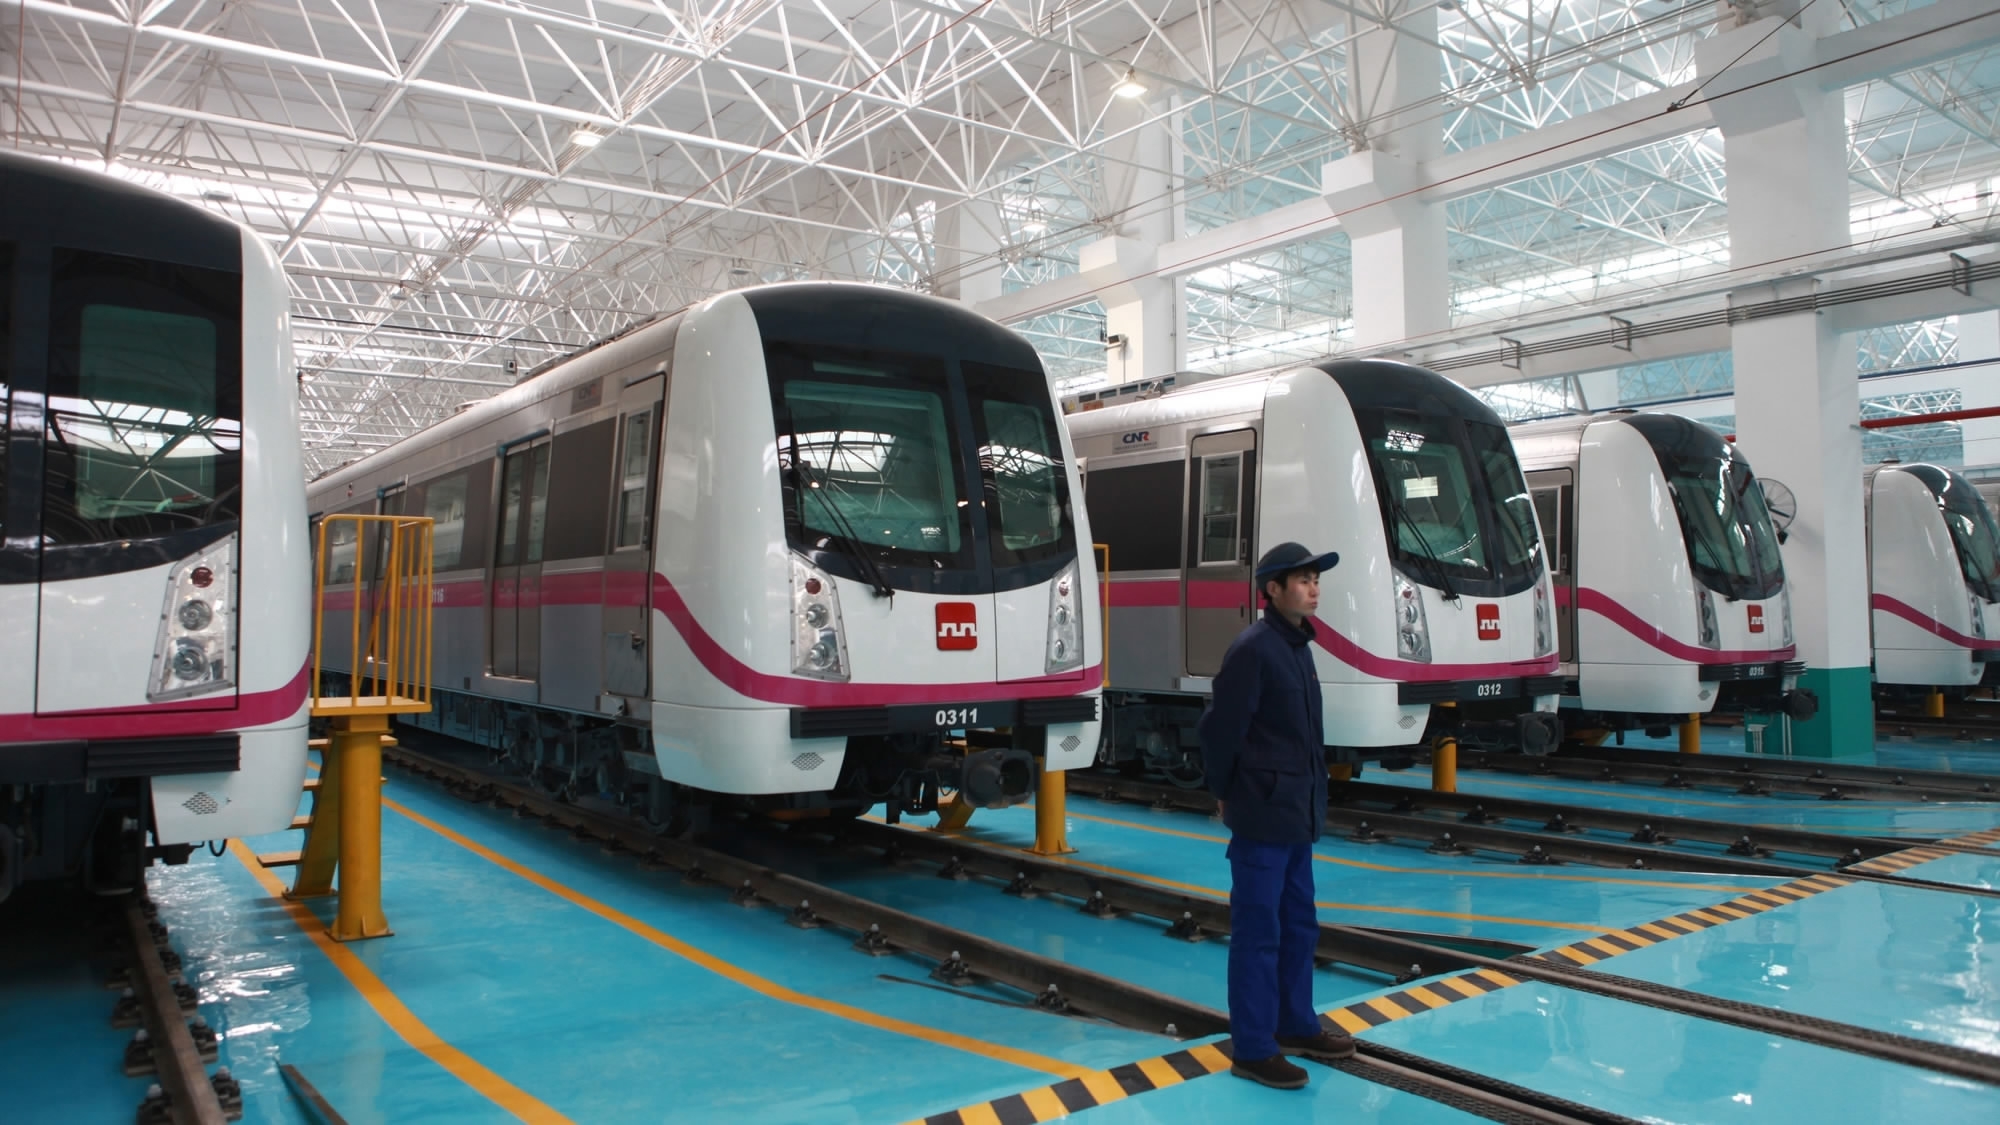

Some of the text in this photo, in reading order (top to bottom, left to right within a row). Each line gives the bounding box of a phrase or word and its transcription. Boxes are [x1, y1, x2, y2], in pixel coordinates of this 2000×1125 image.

[1122, 431, 1149, 443] CNR
[1478, 683, 1501, 697] 0312
[935, 708, 977, 726] 0311
